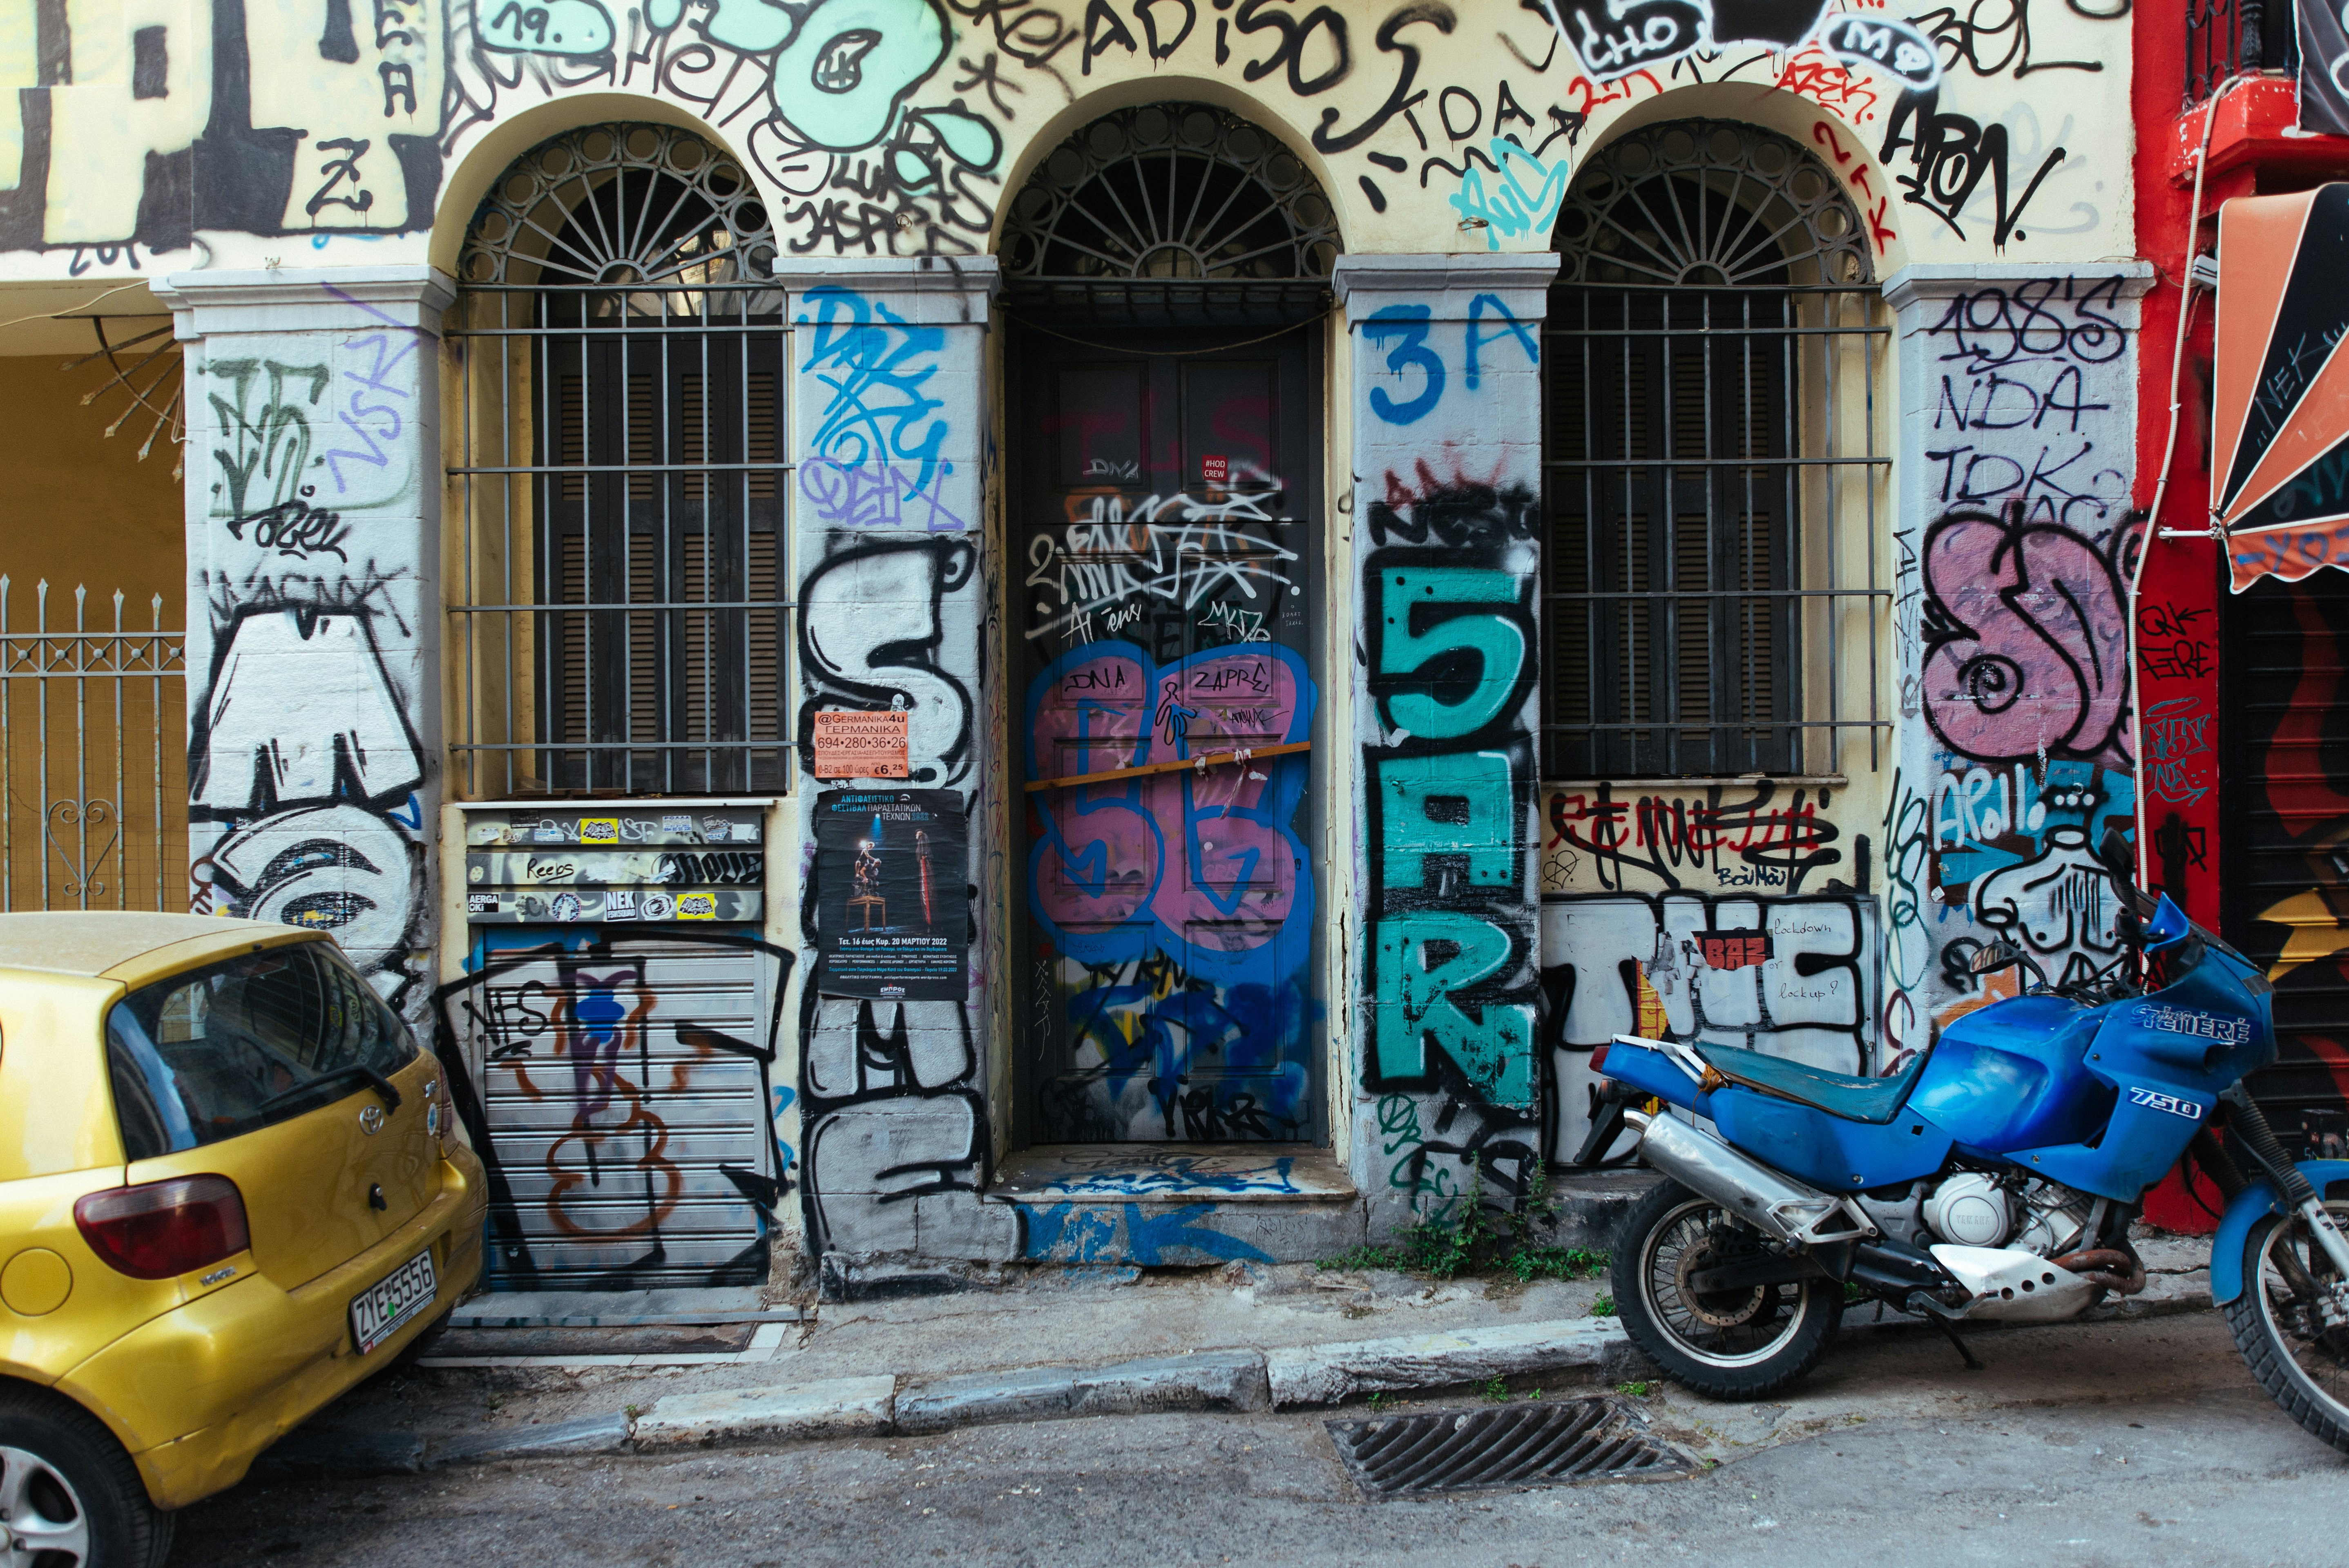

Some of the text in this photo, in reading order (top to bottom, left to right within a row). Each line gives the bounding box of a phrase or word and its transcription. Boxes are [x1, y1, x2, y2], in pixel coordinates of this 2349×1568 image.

[1065, 665, 1125, 692] DNA
[843, 765, 853, 773] 100
[469, 895, 498, 904] AERGA
[606, 891, 635, 910] NEK
[862, 938, 875, 946] έως
[876, 938, 891, 946] Κυρ.
[1768, 961, 1782, 969] or
[2129, 1087, 2202, 1119] 750
[1956, 1215, 1991, 1226] YAMAHA
